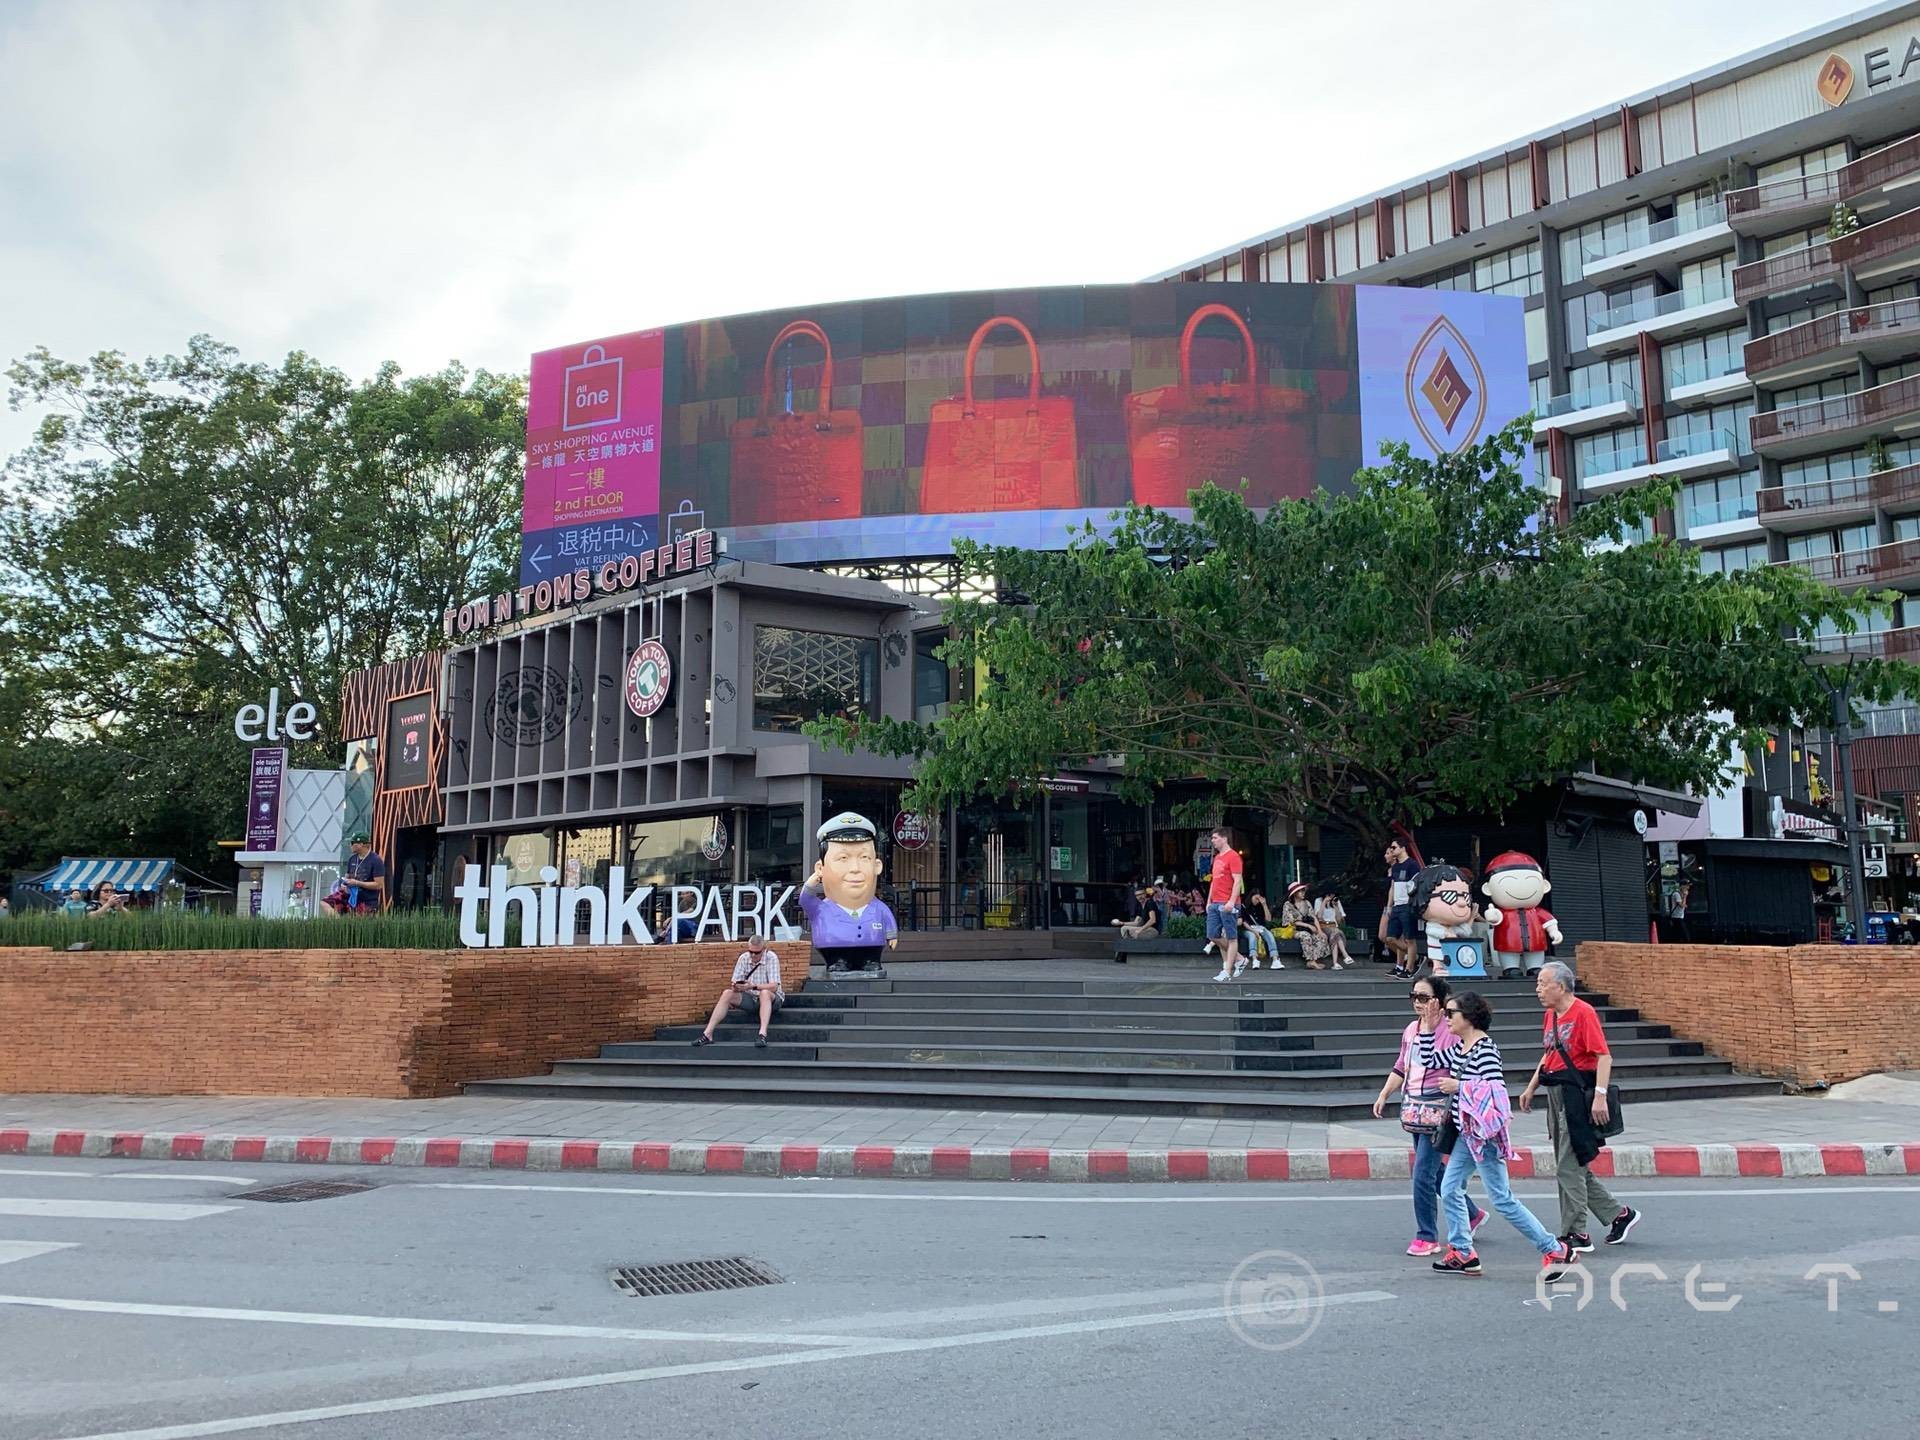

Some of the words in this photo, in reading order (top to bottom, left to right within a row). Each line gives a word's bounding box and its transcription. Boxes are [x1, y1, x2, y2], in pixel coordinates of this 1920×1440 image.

[576, 389, 609, 408] one
[532, 442, 551, 455] SKY
[553, 432, 608, 451] SHOPPING
[611, 424, 655, 440] AVENUE
[565, 496, 580, 511] nd
[584, 491, 624, 507] FLOOR
[554, 511, 584, 522] SHOPPING
[558, 521, 649, 557] 退税中心
[574, 557, 590, 567] VAT
[443, 600, 490, 637] TOM
[495, 591, 512, 622] N
[520, 569, 591, 615] TOMS
[601, 531, 713, 592] COFFEE
[629, 655, 642, 687] TOM
[642, 647, 648, 660] N
[650, 646, 668, 678] TOMS
[630, 685, 665, 712] COFFEE
[235, 687, 316, 741] ele
[1055, 784, 1079, 792] COFFEE
[897, 830, 926, 841] OPEN
[454, 864, 655, 948] think
[671, 885, 800, 943] PARK
